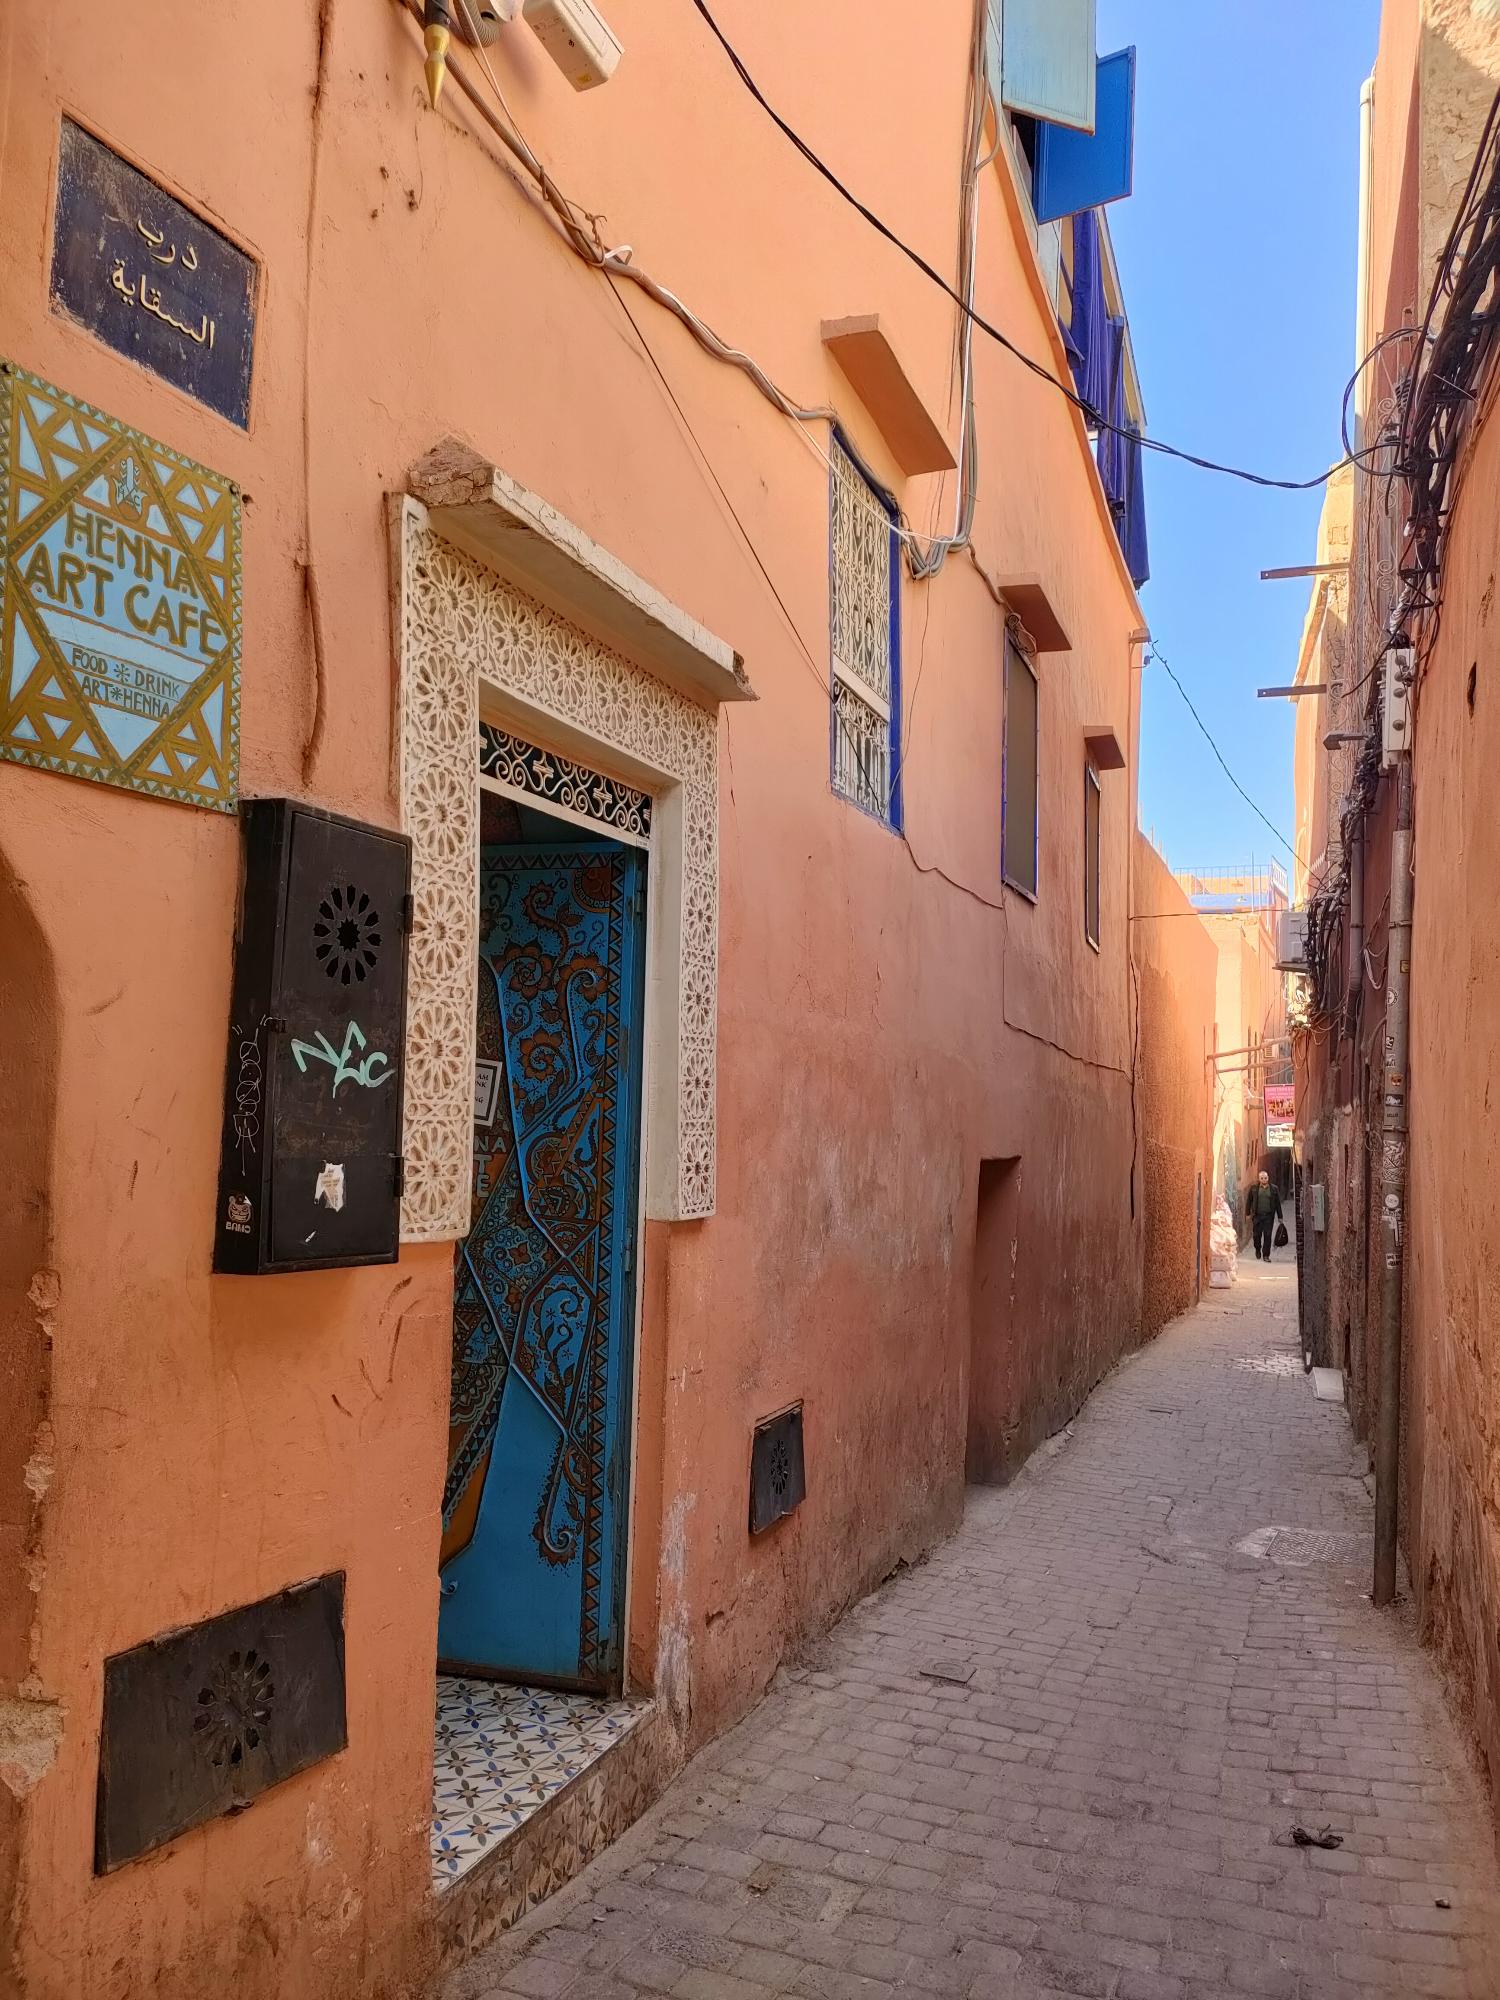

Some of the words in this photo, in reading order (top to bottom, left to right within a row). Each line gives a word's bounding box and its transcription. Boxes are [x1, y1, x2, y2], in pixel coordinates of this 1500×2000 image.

[137, 217, 198, 271] درب
[111, 258, 216, 350] السقاية
[65, 502, 199, 599] HENNA
[24, 542, 114, 618] ART
[124, 584, 222, 656] CAFE
[72, 648, 108, 675] FOOD
[135, 669, 180, 697] DRINK
[80, 676, 113, 702] ART
[123, 687, 170, 718] HENNA
